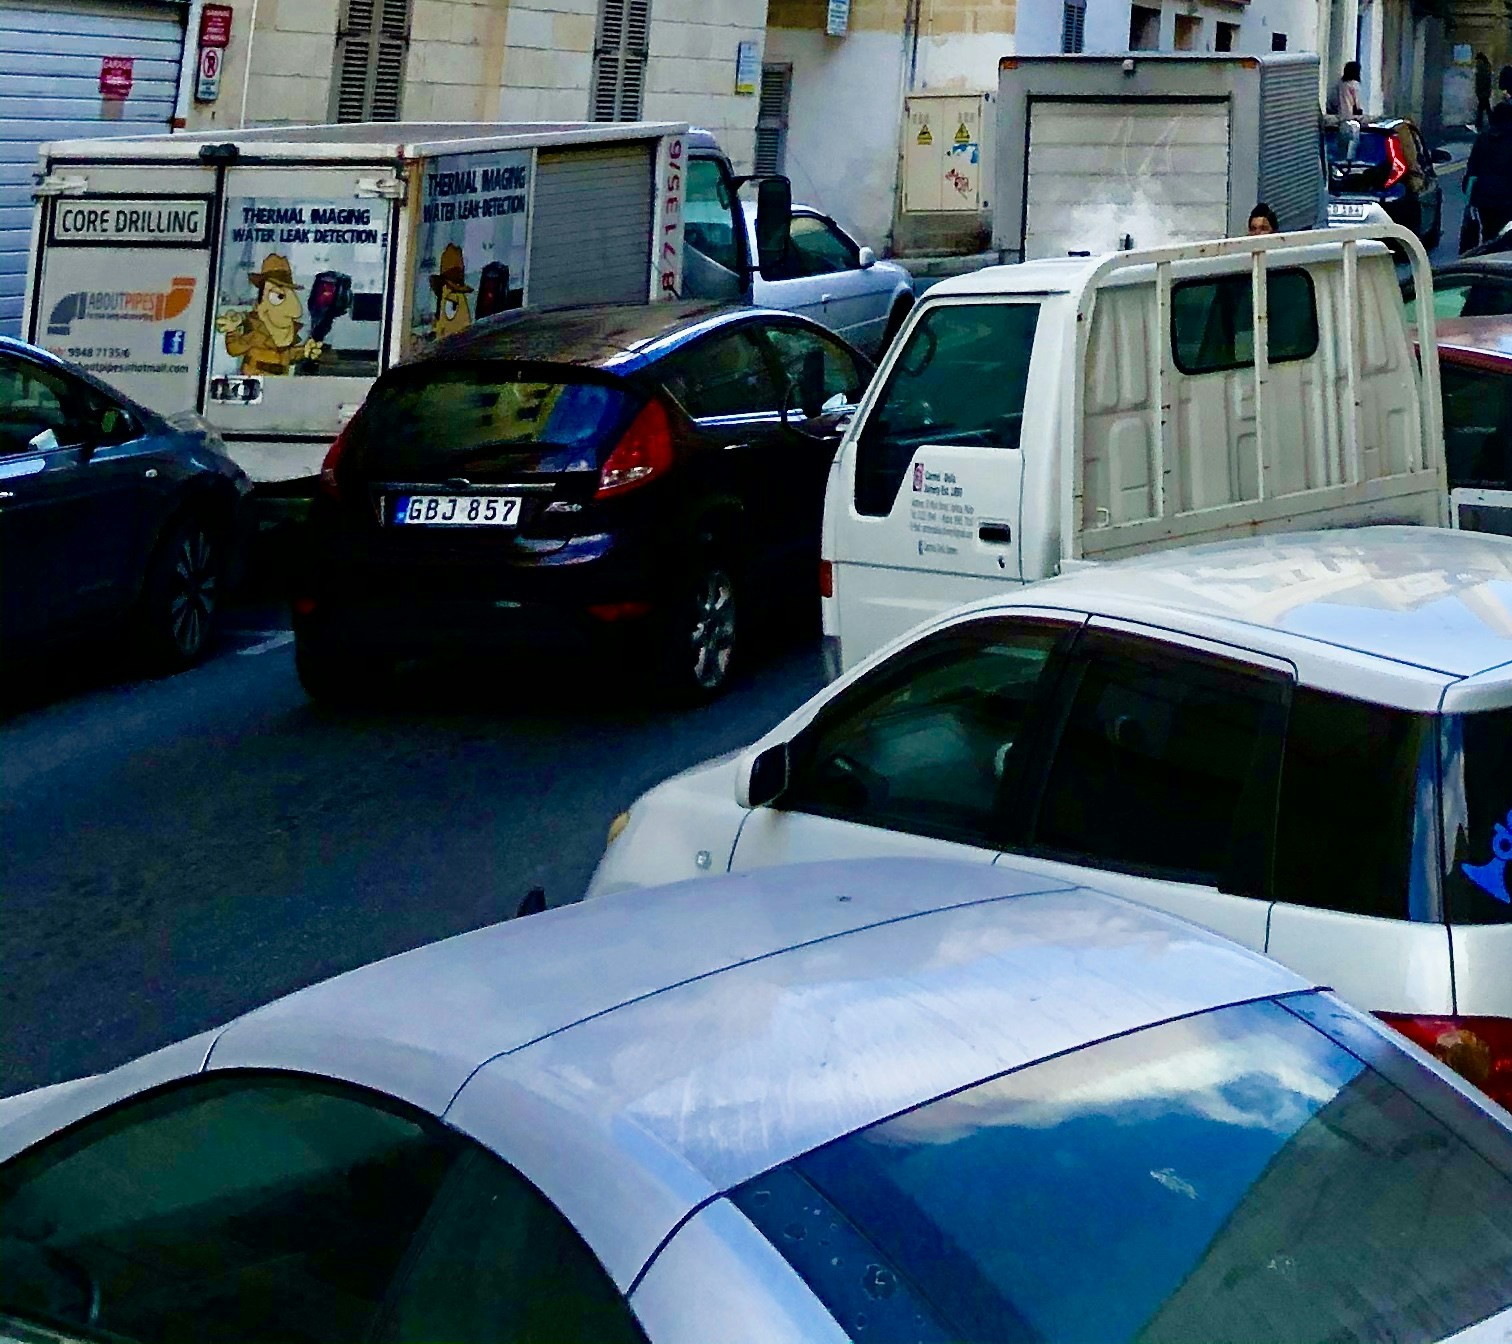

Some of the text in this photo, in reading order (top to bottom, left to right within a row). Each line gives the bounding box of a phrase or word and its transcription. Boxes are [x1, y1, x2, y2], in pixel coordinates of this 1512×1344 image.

[428, 170, 478, 196] THERMAL
[62, 209, 199, 234] CORE DRILLING
[242, 207, 371, 225] THERMAL IMAGING
[423, 201, 456, 223] WATER
[232, 228, 276, 243] WATER
[279, 228, 310, 244] LEAK
[313, 228, 378, 244] DETECTION
[88, 292, 156, 310] ABOUTPIPES
[408, 497, 459, 521] GBJ
[467, 498, 518, 522] 857
